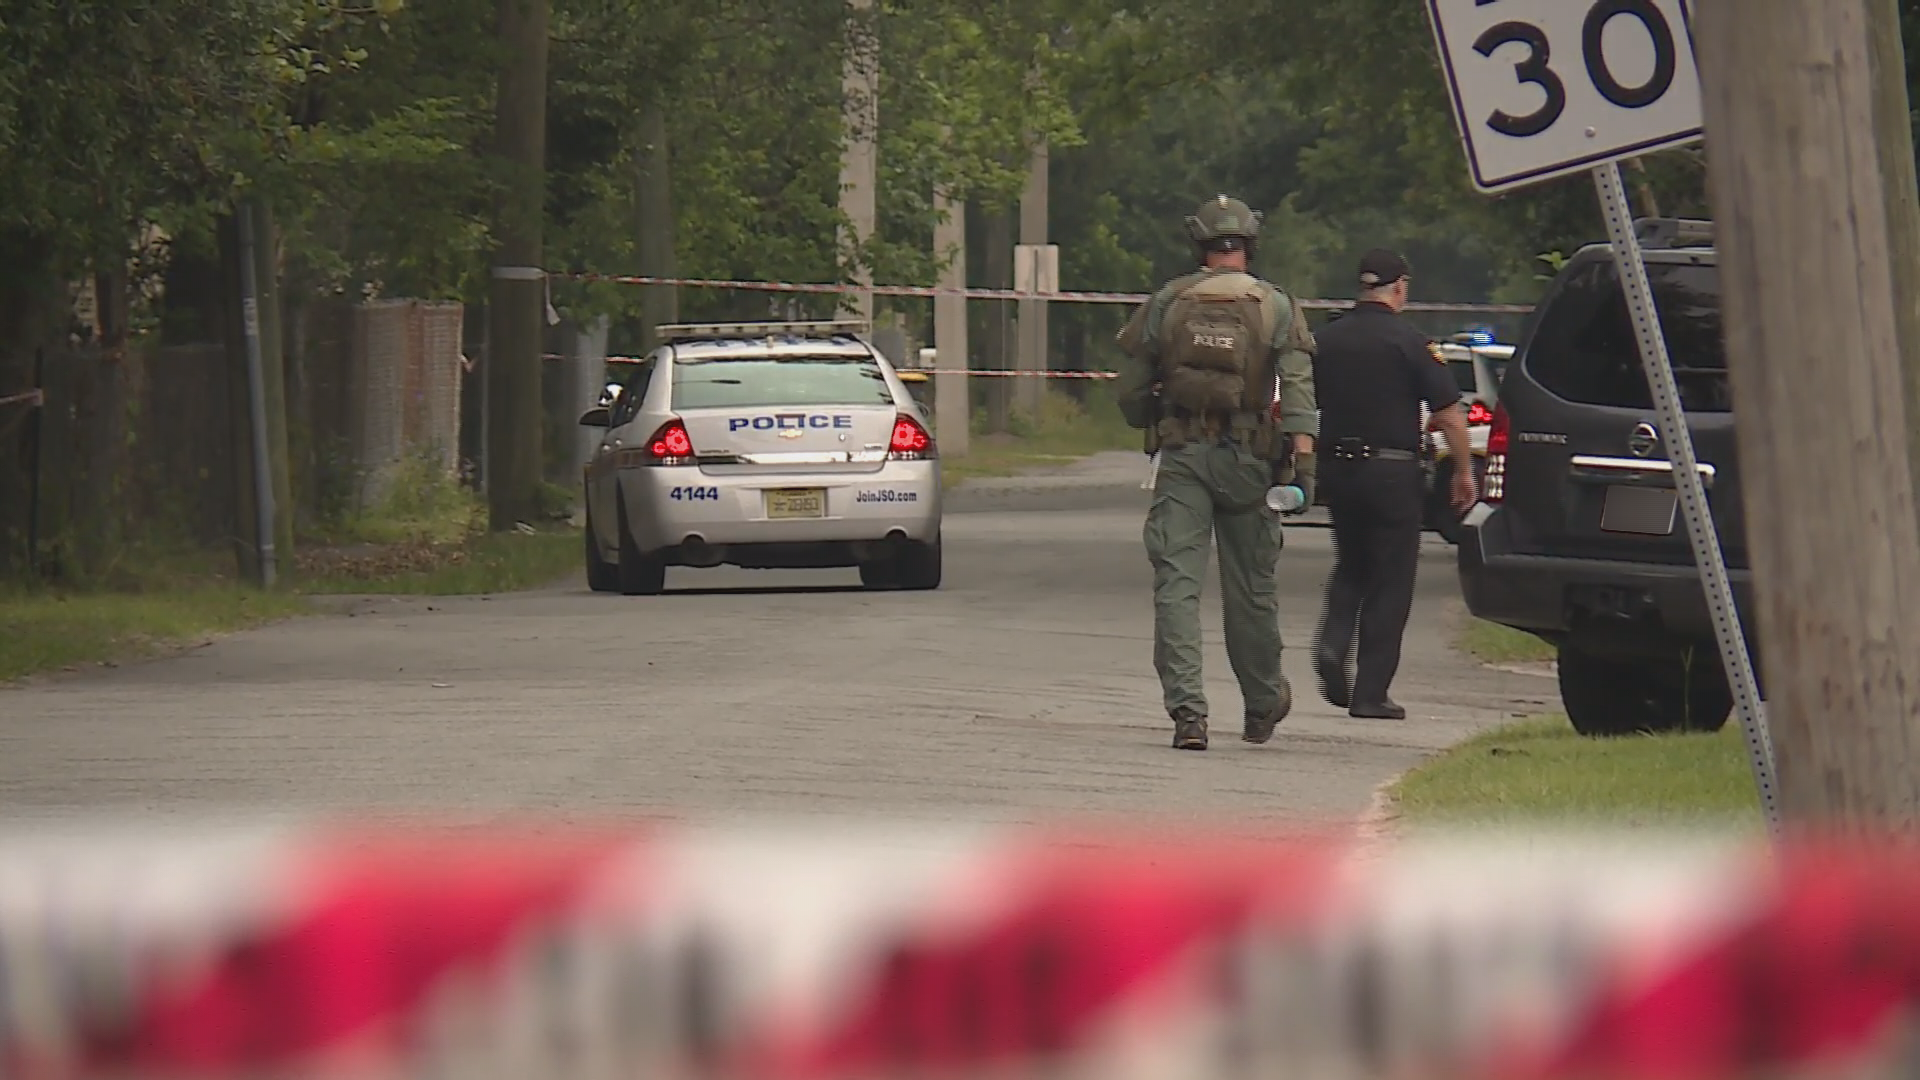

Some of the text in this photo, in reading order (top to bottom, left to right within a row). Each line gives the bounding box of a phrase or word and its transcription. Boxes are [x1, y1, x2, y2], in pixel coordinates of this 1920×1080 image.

[1472, 0, 1676, 137] 30
[1193, 333, 1234, 349] POLICE
[729, 414, 852, 431] POLICE
[670, 486, 719, 501] 4144
[856, 489, 917, 503] JoinJSO.com
